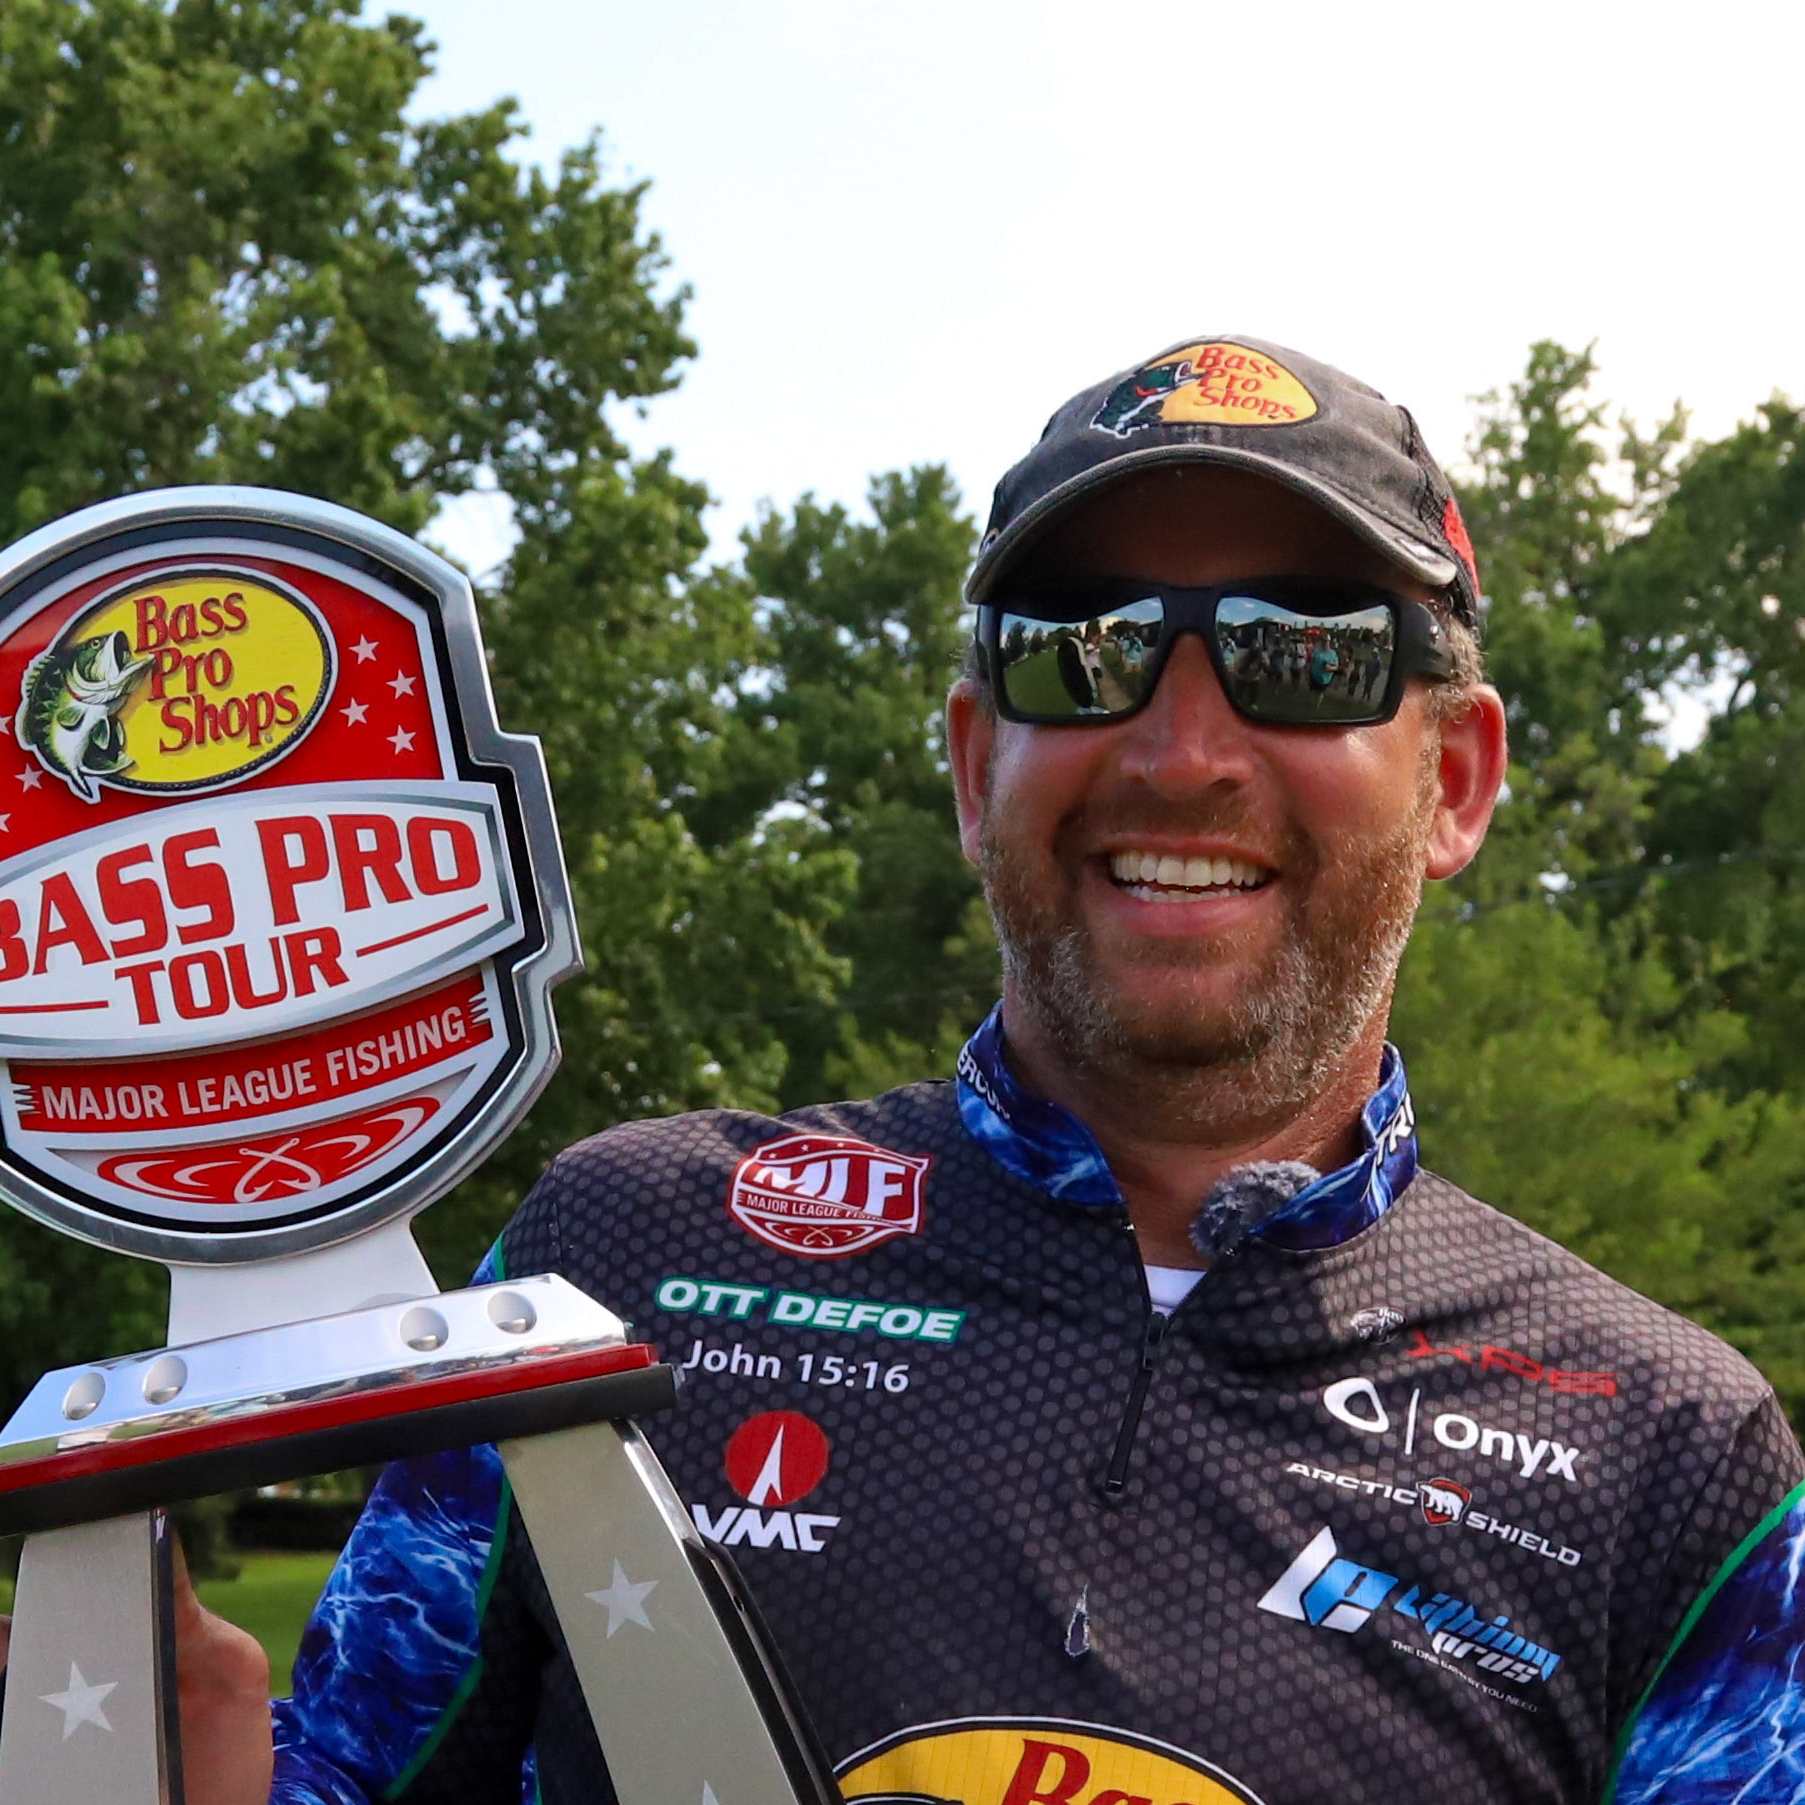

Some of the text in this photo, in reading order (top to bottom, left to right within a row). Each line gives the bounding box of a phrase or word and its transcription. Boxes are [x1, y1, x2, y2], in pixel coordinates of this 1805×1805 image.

[1196, 346, 1279, 380] Bass
[1197, 368, 1262, 392] Pro
[1193, 386, 1297, 419] Shops
[133, 592, 248, 654] Bass
[147, 646, 233, 702] Pro
[158, 684, 300, 754] Shops
[254, 812, 483, 929] PRO
[114, 925, 351, 1027] TOUR
[41, 1006, 468, 1121] MAJOR LEAGUE FISHING
[746, 1193, 789, 1214] MAJOR
[791, 1201, 841, 1218] LEAGUE
[752, 1157, 907, 1218] MLF
[657, 1279, 963, 1340] OTT DEFOE
[683, 1340, 910, 1393] John 15:16
[1433, 1412, 1581, 1482] Onyx
[691, 1503, 842, 1552] VMC
[1285, 1461, 1583, 1568] ARCTIC SHIELD
